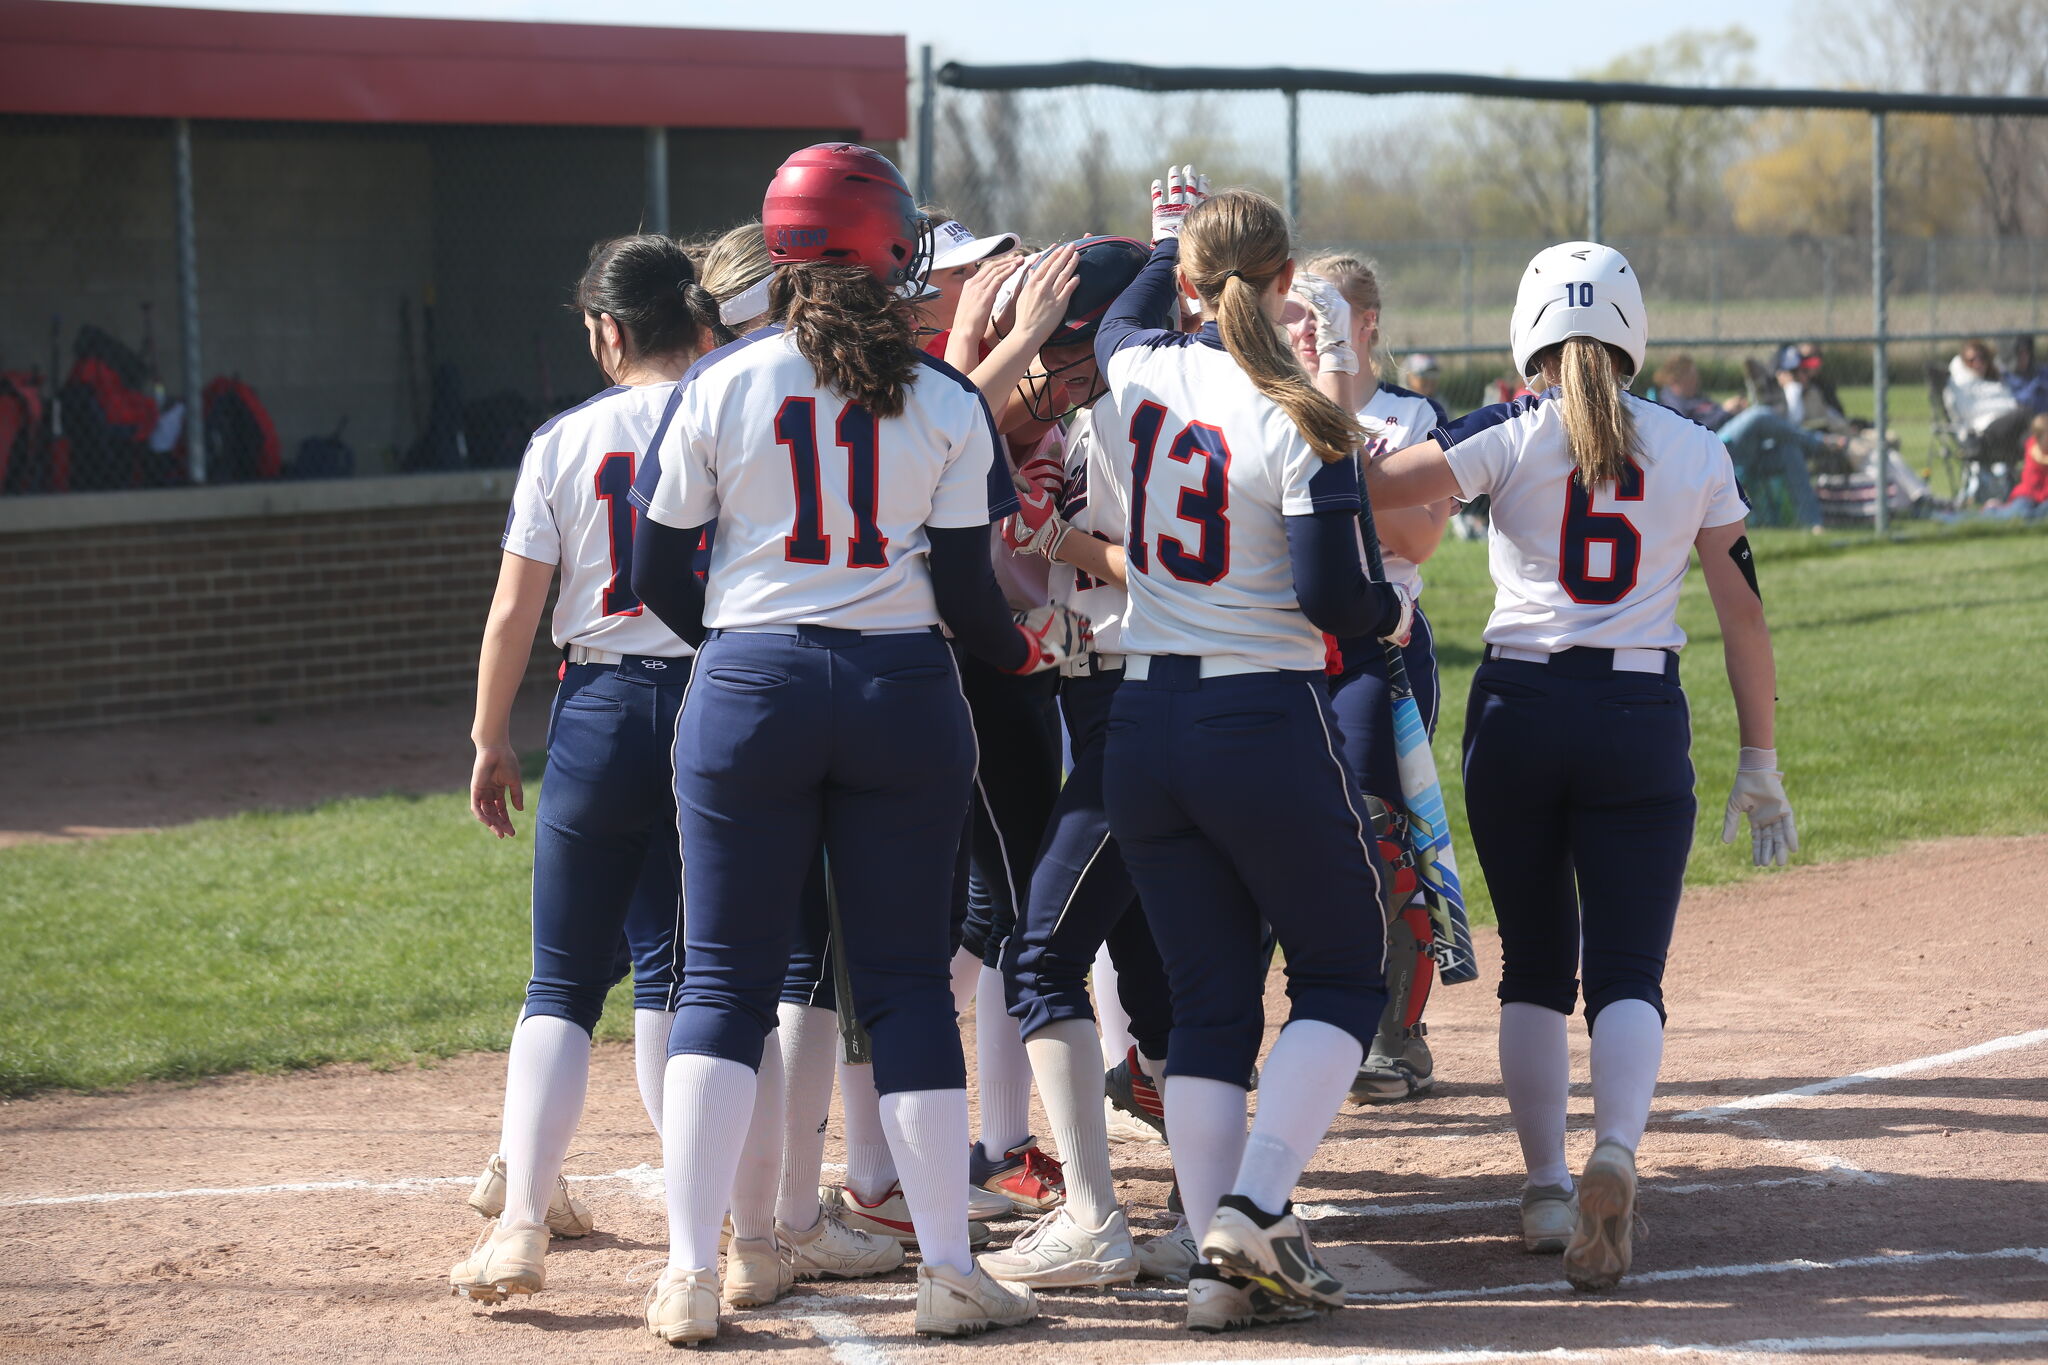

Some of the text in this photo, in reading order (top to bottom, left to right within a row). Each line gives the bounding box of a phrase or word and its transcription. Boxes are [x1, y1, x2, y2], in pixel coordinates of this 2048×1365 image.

[1565, 282, 1594, 308] 10
[774, 396, 890, 569] 11
[1128, 399, 1232, 586] 13
[1558, 454, 1645, 605] 6
